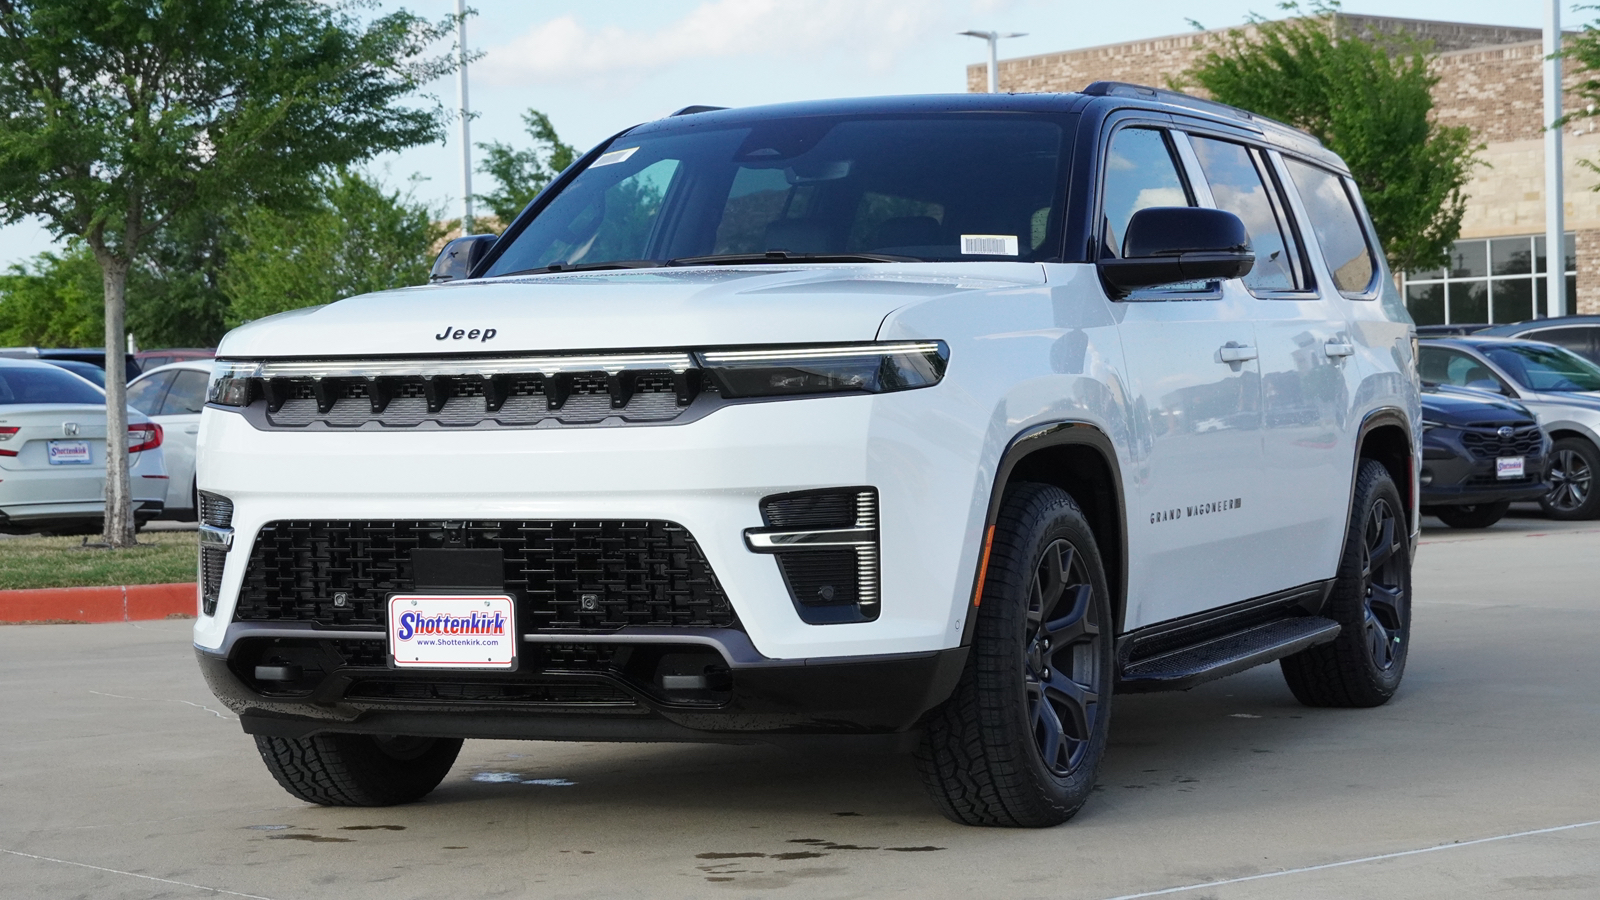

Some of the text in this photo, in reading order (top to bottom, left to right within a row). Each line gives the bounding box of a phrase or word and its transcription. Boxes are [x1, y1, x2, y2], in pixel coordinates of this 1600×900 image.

[435, 326, 497, 343] Jeep
[1150, 499, 1234, 524] GRAND WAGONEER
[398, 611, 506, 641] Shottenkirk
[416, 638, 499, 646] www.Shottenkirk.com
